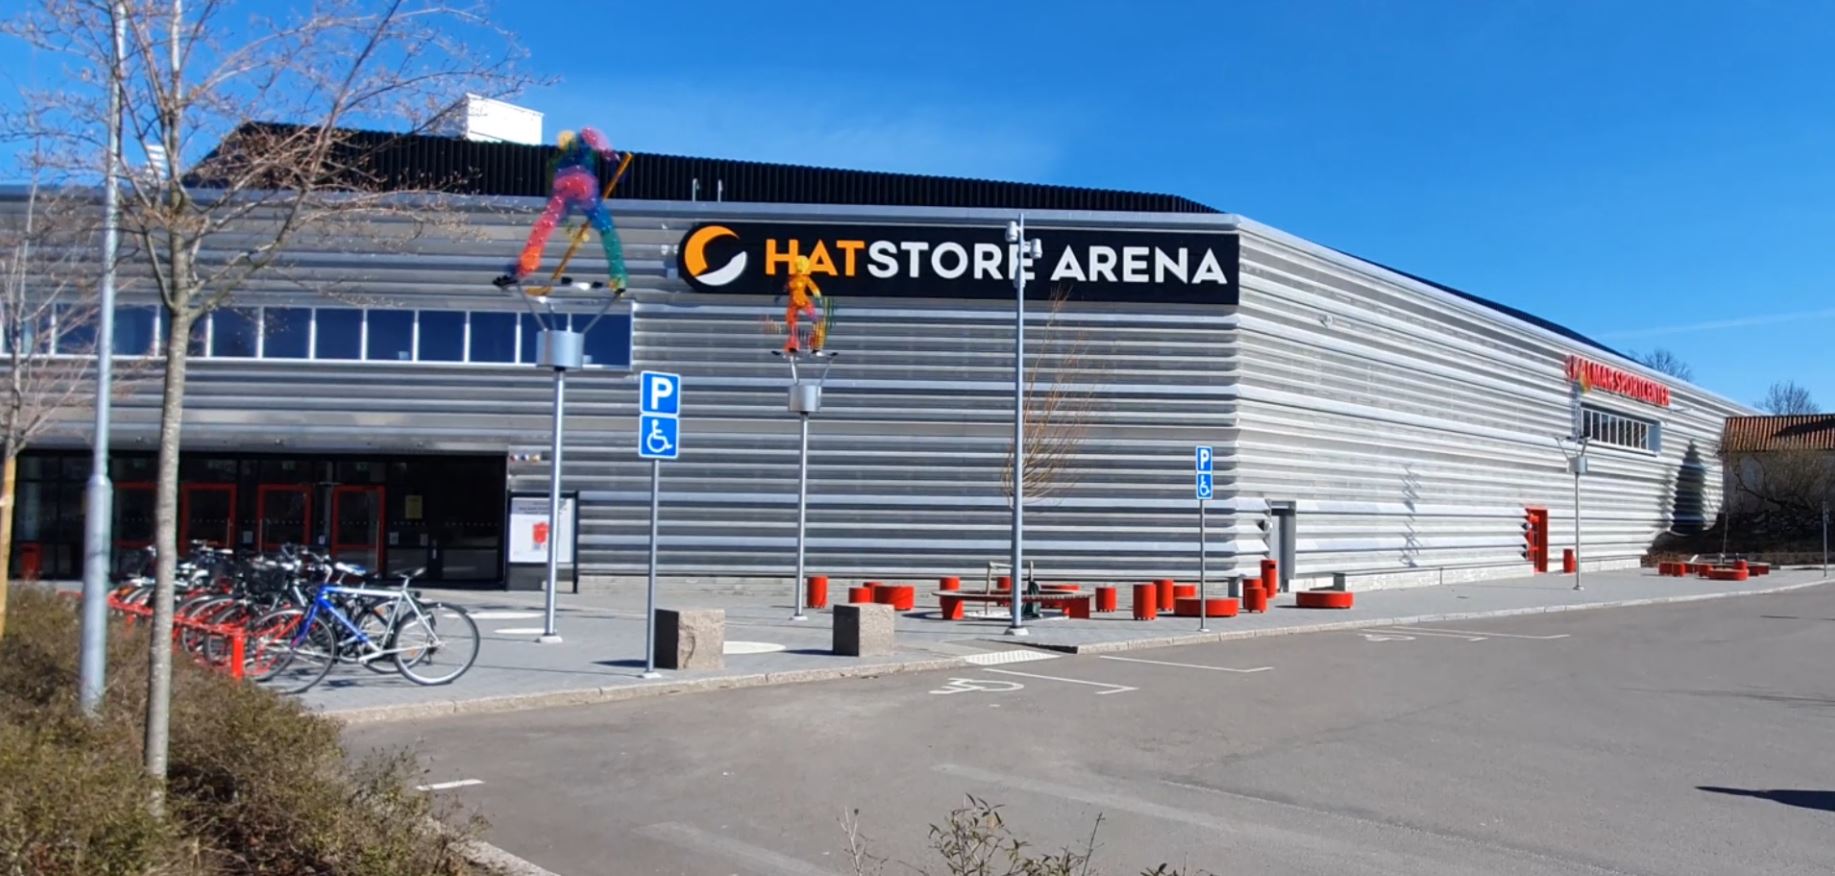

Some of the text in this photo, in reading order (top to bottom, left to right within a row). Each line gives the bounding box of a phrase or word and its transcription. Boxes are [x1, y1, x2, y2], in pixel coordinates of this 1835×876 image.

[765, 238, 1228, 284] HATSTORE ARENA
[651, 376, 673, 410] P
[1200, 449, 1209, 469] P
